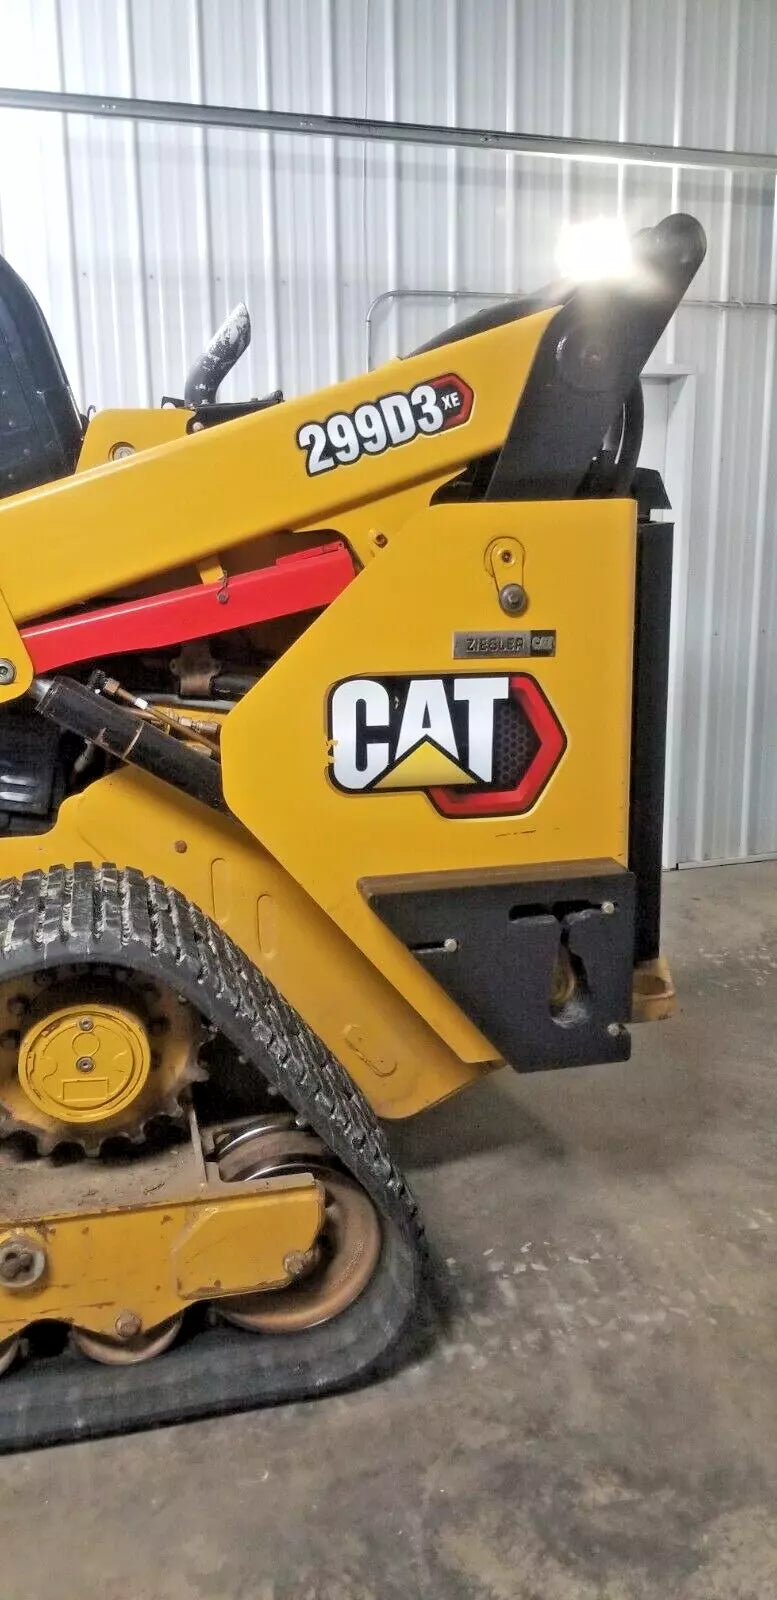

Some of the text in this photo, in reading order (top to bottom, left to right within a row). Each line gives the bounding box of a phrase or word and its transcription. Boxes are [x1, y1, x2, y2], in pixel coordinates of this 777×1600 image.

[299, 385, 461, 474] 299D3 XE
[466, 637, 525, 652] ZIEGLER
[332, 677, 509, 789] CAT
